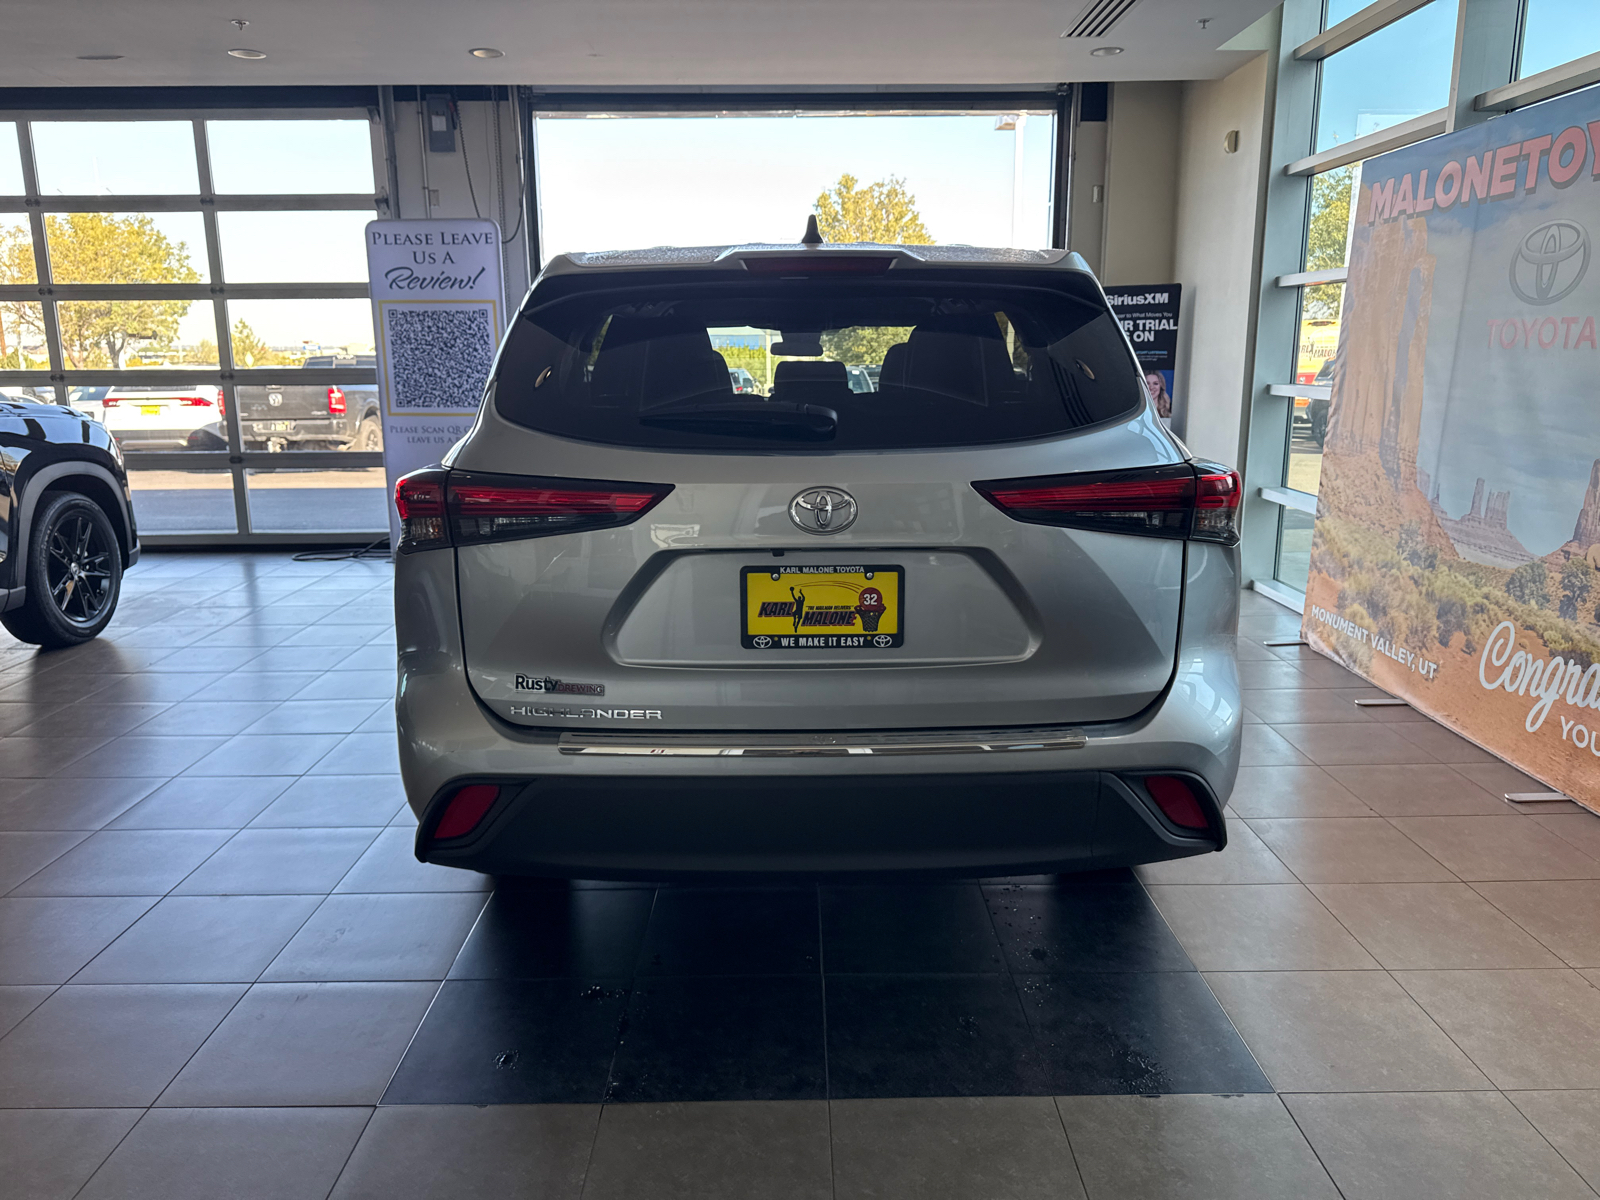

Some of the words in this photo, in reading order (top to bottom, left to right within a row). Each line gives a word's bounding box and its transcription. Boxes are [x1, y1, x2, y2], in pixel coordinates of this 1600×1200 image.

[442, 251, 456, 265] A
[384, 266, 486, 291] Review!
[1106, 293, 1169, 305] SiriusXM
[1136, 319, 1178, 331] TRIAL
[1133, 330, 1155, 342] ON
[1487, 316, 1598, 350] TOYOTA
[447, 425, 462, 435] QR
[407, 436, 431, 444] LEAVE
[434, 436, 445, 444] US
[780, 566, 800, 574] KARL
[802, 566, 834, 574] MALONE
[863, 594, 878, 605] 32
[758, 601, 795, 618] KARL
[801, 610, 856, 627] MALONE
[781, 637, 795, 647] WE
[799, 637, 826, 647] MAKE
[829, 637, 837, 647] IT
[841, 637, 865, 647] EASY
[1311, 604, 1369, 643] MONUMENT
[1370, 632, 1416, 672] VALLEY,
[1418, 660, 1438, 679] UT
[515, 675, 559, 691] Rusty
[510, 706, 663, 720] HIGHLANDER
